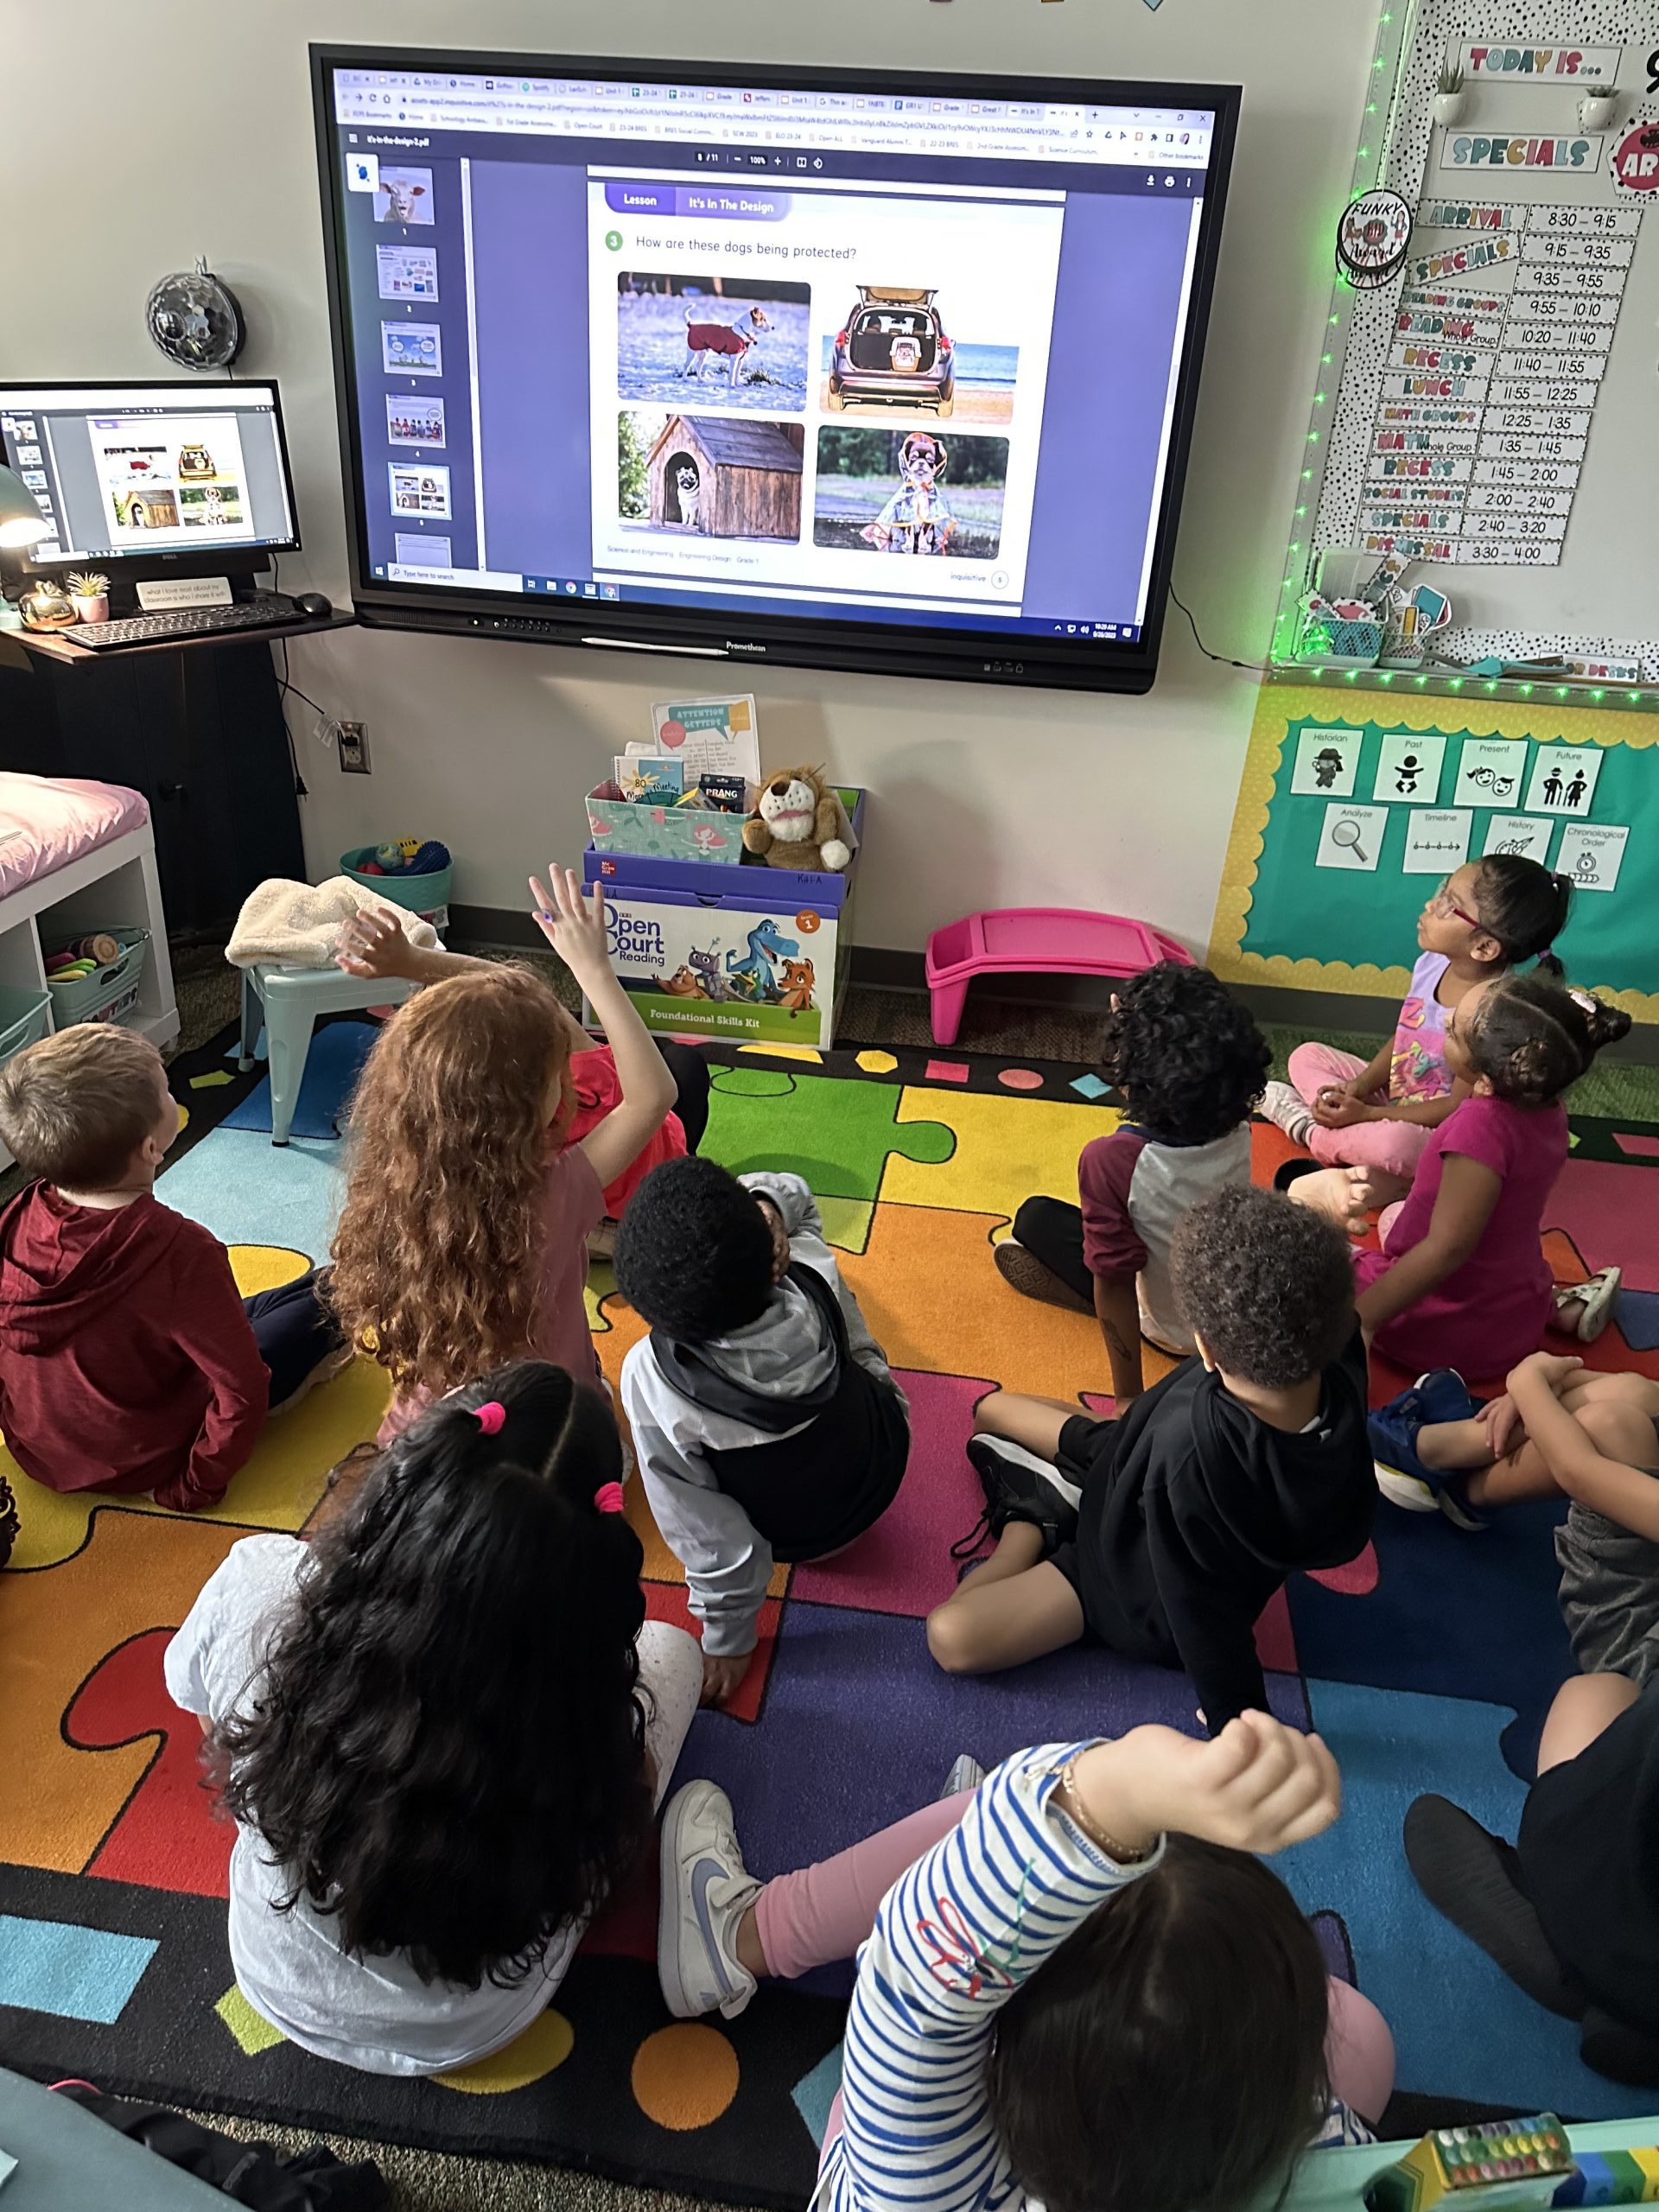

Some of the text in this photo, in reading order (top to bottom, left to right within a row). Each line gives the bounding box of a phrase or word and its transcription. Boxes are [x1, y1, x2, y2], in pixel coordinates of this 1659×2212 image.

[1471, 48, 1553, 73] TODAY
[1453, 137, 1590, 167] SPECIALS
[624, 194, 657, 206] Lesson
[690, 197, 774, 213] It's In The Design
[1351, 202, 1403, 215] FUNKY
[1430, 206, 1512, 228] ARRIVAL
[1548, 213, 1617, 228] 8:30 9:15
[637, 236, 856, 259] How are these dogs being protected?
[1545, 243, 1611, 259] 9:15 9:35
[1416, 239, 1510, 283] SPECIALS
[1534, 272, 1603, 288] 9:35 9:55
[1402, 292, 1505, 313] READING GROUPS
[1530, 301, 1601, 316] 9:55 10:10
[1398, 315, 1474, 336] READING
[1522, 330, 1596, 345] 10:20 11:40
[1403, 348, 1476, 372] RECESS
[1514, 358, 1585, 373] 11:40 11:55
[1403, 378, 1465, 397] LUNCH
[1504, 386, 1577, 400] 11:55 12:25
[1384, 408, 1476, 423] MATH GROUPS
[1503, 414, 1571, 429] 12:25 1:35
[1377, 433, 1431, 450] MATH
[1446, 442, 1471, 452] Group
[1500, 440, 1561, 454] 1:35 1:45
[1384, 459, 1456, 476] RECESS
[1491, 467, 1558, 480] 1:45 2:00
[1363, 487, 1464, 501] SOCIAL STUDIES
[1485, 493, 1555, 508] 2:00 2:40
[1371, 512, 1449, 529] SPECIALS
[1478, 520, 1546, 533] 2:40 3:20
[642, 549, 673, 558] Engineering
[1366, 536, 1450, 558] DISMISSAL
[1472, 546, 1541, 559] 3:30 4:00
[679, 552, 711, 561] Engineering
[950, 572, 986, 583] inquisitive
[727, 640, 766, 652] Promethean
[1588, 664, 1637, 679] DESKS
[677, 708, 724, 719] ATTENTION
[684, 719, 721, 728] GETTERS
[1313, 734, 1348, 743] Historian
[1405, 740, 1422, 748] Past
[1479, 745, 1510, 753] Present
[1556, 752, 1582, 761] Future
[635, 779, 646, 787] 80
[653, 781, 680, 793] Meeting
[706, 788, 738, 798] PRANG
[1341, 809, 1372, 819] Analyze
[1508, 821, 1535, 830] History
[1567, 827, 1625, 840] Chronological
[1582, 838, 1606, 848] Order
[805, 920, 813, 930] 1
[620, 950, 664, 967] Reading
[650, 1009, 760, 1028] Foundational Skills Kit
